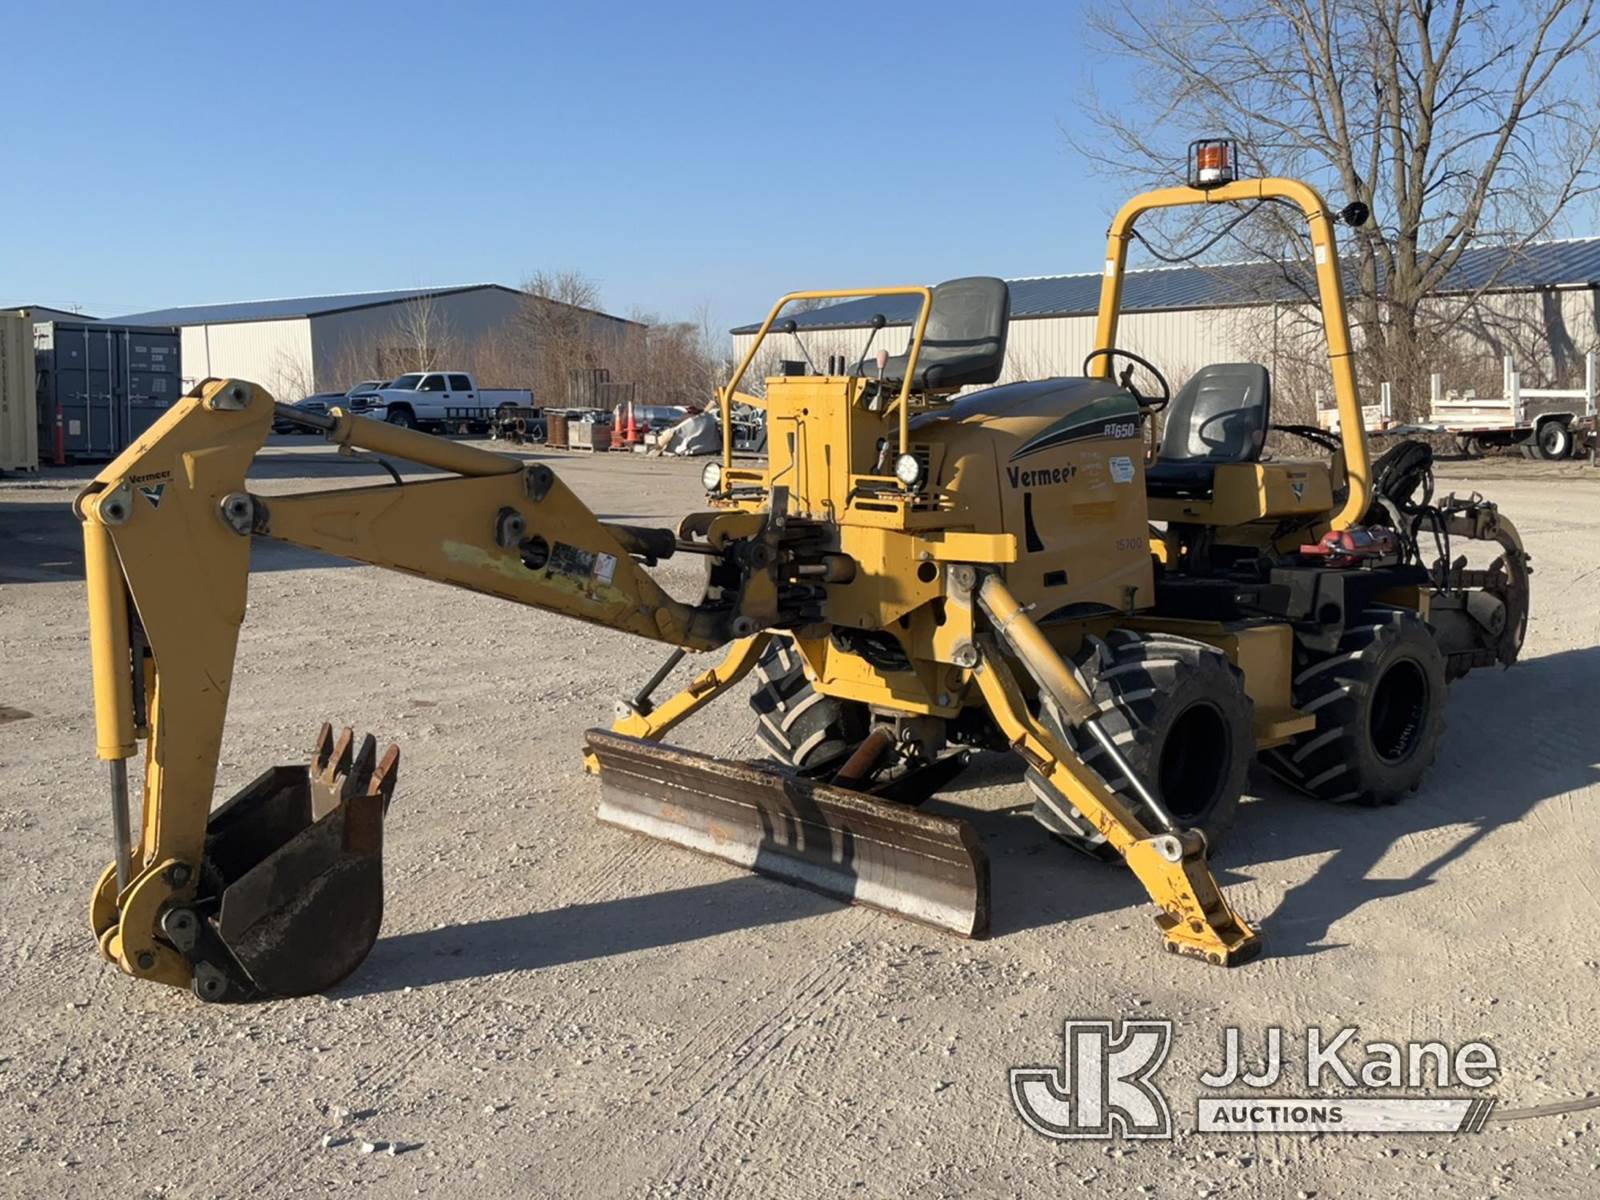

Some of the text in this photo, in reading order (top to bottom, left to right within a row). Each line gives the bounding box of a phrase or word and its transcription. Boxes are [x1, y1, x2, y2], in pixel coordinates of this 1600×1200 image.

[1103, 422, 1136, 438] RT650
[128, 470, 171, 484] Vermeer
[1006, 464, 1077, 489] Vermeer
